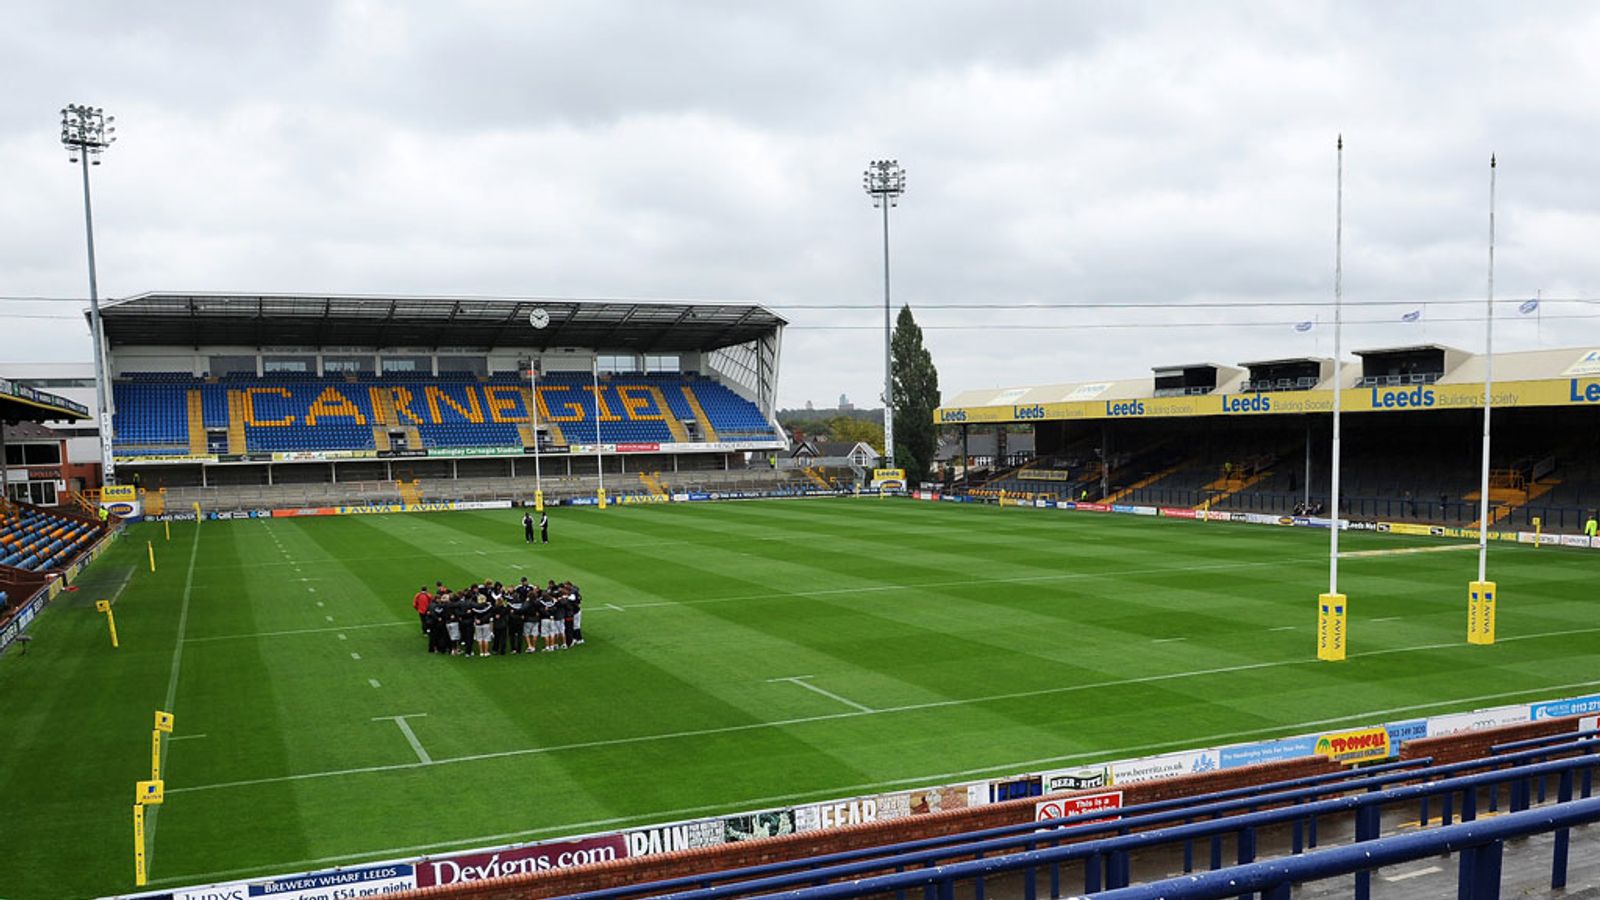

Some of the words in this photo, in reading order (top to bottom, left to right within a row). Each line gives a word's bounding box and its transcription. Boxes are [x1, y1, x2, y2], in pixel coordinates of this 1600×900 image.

[242, 385, 668, 426] CARNEGIE
[1222, 393, 1270, 412] Leeds
[1273, 400, 1303, 410] Building
[1372, 385, 1435, 408] Leeds
[1439, 394, 1477, 408] Building
[940, 408, 967, 421] Leeds
[1013, 404, 1045, 419] Leeds
[1106, 399, 1144, 416] Leeds
[876, 469, 900, 477] Leeds
[104, 486, 132, 496] Leeds
[633, 495, 666, 503] AVIVA
[351, 505, 392, 513] AVIVA
[411, 503, 451, 511] AVIVA
[156, 514, 173, 522] LAND
[173, 513, 196, 521] ROVER
[1483, 605, 1491, 634] AVIVA
[1333, 619, 1341, 650] AVIVA
[1331, 732, 1386, 753] TROPICAL
[1051, 778, 1075, 789] BEER
[1076, 800, 1093, 809] This
[1094, 799, 1103, 807] is
[821, 799, 877, 830] FEAR
[631, 825, 689, 857] PAIN
[430, 844, 617, 887] Devigns.com
[264, 878, 317, 894] BREWERY
[319, 872, 361, 887] WHARF
[363, 867, 397, 880] LEEDS
[333, 887, 356, 900] £54
[359, 885, 379, 897] per
[382, 881, 413, 894] night
